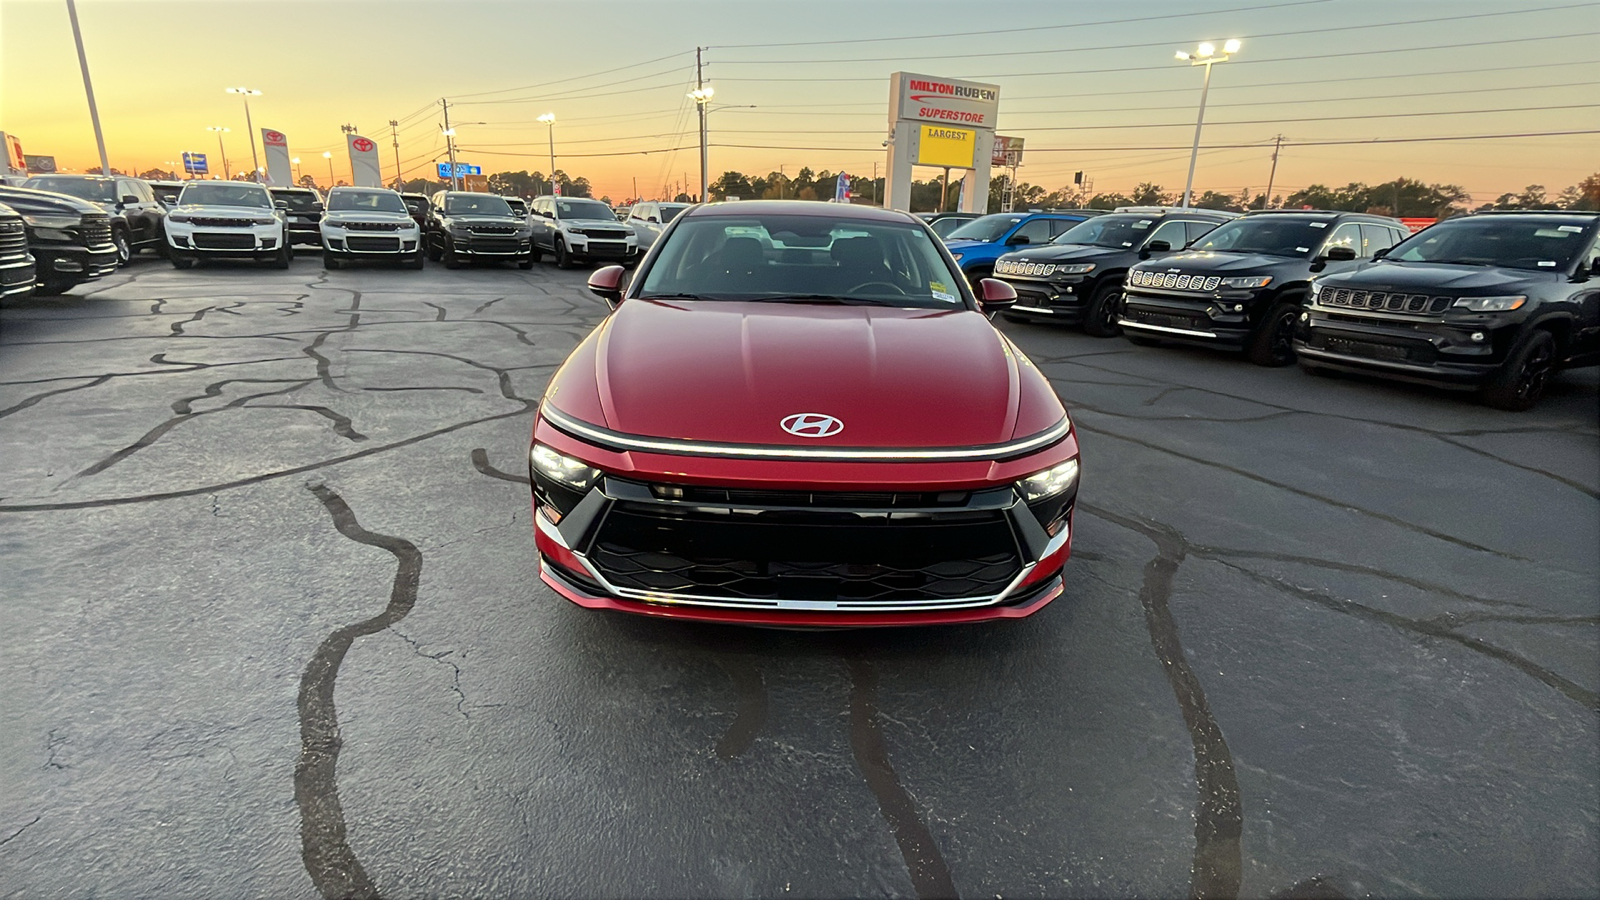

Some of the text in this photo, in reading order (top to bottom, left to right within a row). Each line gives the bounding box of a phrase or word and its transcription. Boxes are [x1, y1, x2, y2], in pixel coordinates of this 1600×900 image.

[910, 80, 995, 101] MILTON RUBEN
[919, 107, 984, 123] SUPERSTORE
[928, 128, 967, 140] LARGEST
